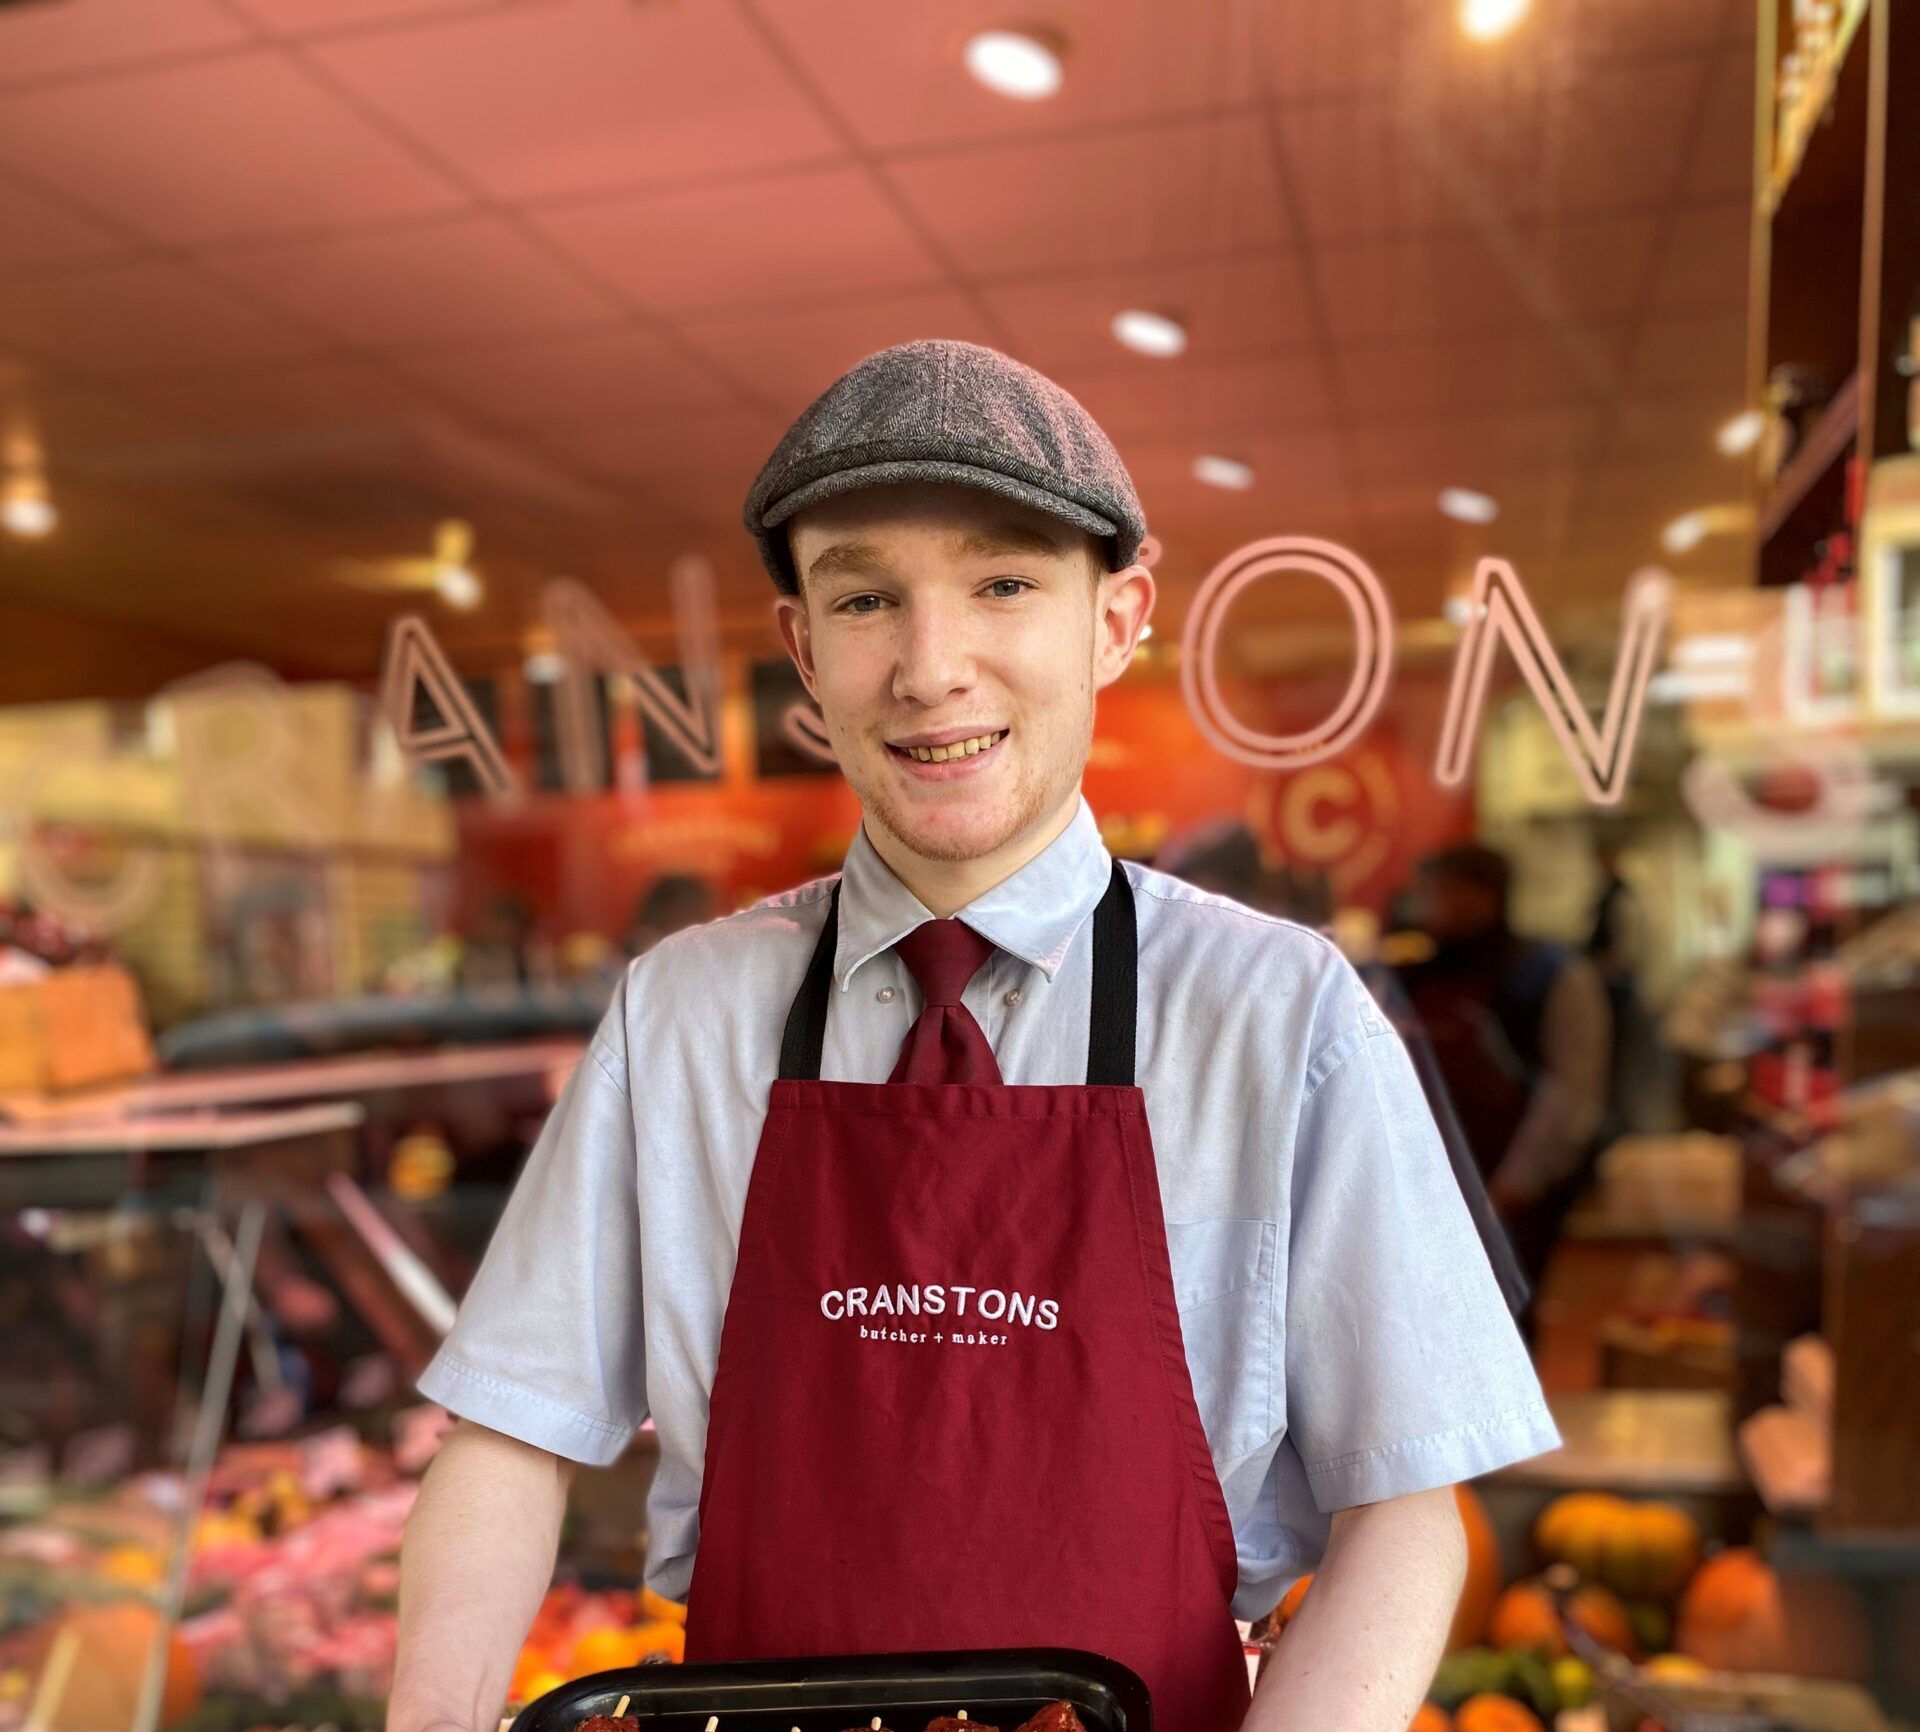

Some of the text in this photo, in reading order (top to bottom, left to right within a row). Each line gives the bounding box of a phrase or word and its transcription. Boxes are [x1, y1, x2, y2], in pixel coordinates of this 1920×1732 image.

[22, 535, 1885, 925] CRANONS
[820, 1284, 1059, 1330] CRANSTONS
[859, 1325, 927, 1344] butcher
[951, 1330, 1009, 1346] maker
